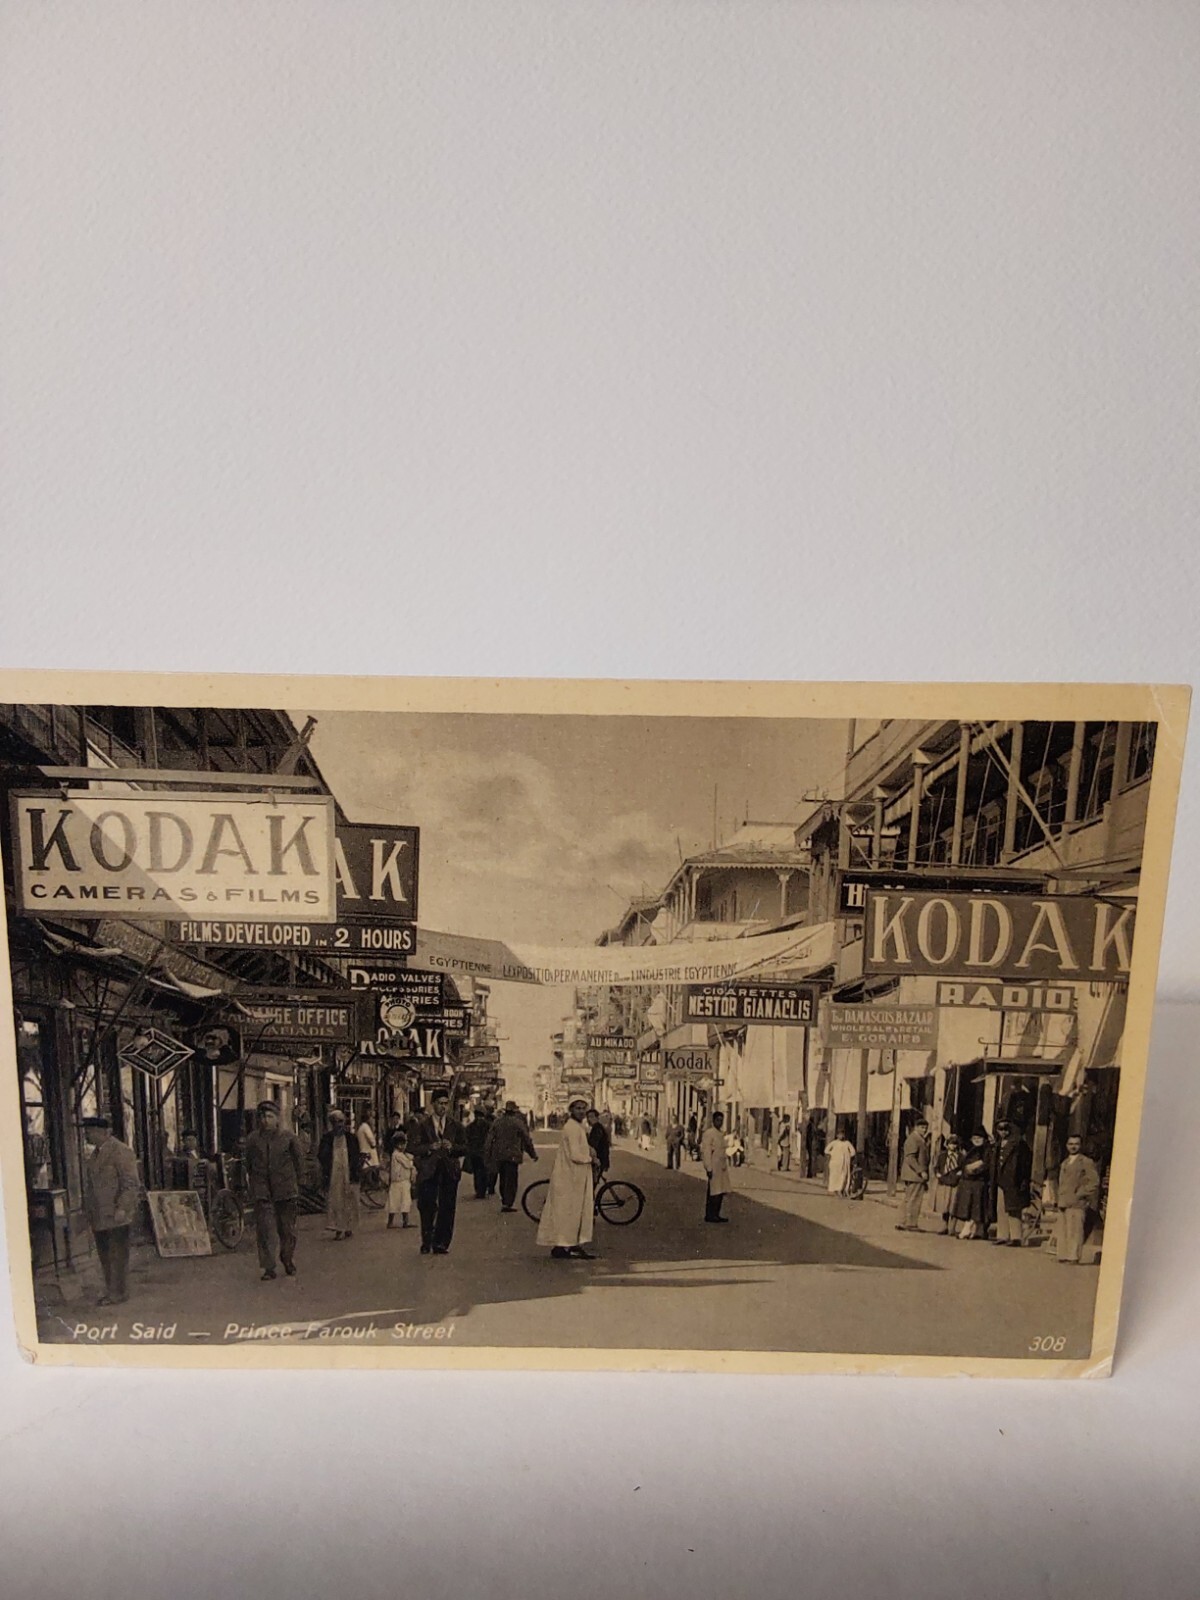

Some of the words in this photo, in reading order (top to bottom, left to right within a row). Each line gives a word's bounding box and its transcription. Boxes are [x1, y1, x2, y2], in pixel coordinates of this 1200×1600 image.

[25, 808, 320, 876] KODAK
[30, 884, 199, 902] CAMERAS
[225, 888, 320, 904] FILMS
[180, 922, 222, 943] FILMS
[226, 923, 311, 946] DEVELOPED
[315, 939, 328, 947] IN
[334, 928, 350, 948] 2
[361, 929, 412, 950] HOURS
[869, 895, 1137, 972] KODAK
[429, 955, 492, 973] EGYPTIENNE
[401, 974, 441, 983] VALVES
[703, 986, 798, 998] CIGARETTES
[940, 984, 1071, 1009] RADIO
[688, 995, 737, 1017] NESTOR
[743, 997, 810, 1020] GIANACLIS
[298, 1008, 348, 1026] OFFICE
[844, 1010, 894, 1024] DAMASCUS
[896, 1011, 934, 1025] BAZAAR
[590, 1036, 601, 1048] AU
[604, 1037, 635, 1048] MIKADO
[664, 1050, 713, 1071] Kodak
[73, 1323, 119, 1340] Port
[129, 1322, 178, 1340] Said
[224, 1322, 292, 1340] Prince
[304, 1322, 379, 1340] Farouk
[391, 1322, 456, 1340] Street
[1028, 1335, 1067, 1352] 308
